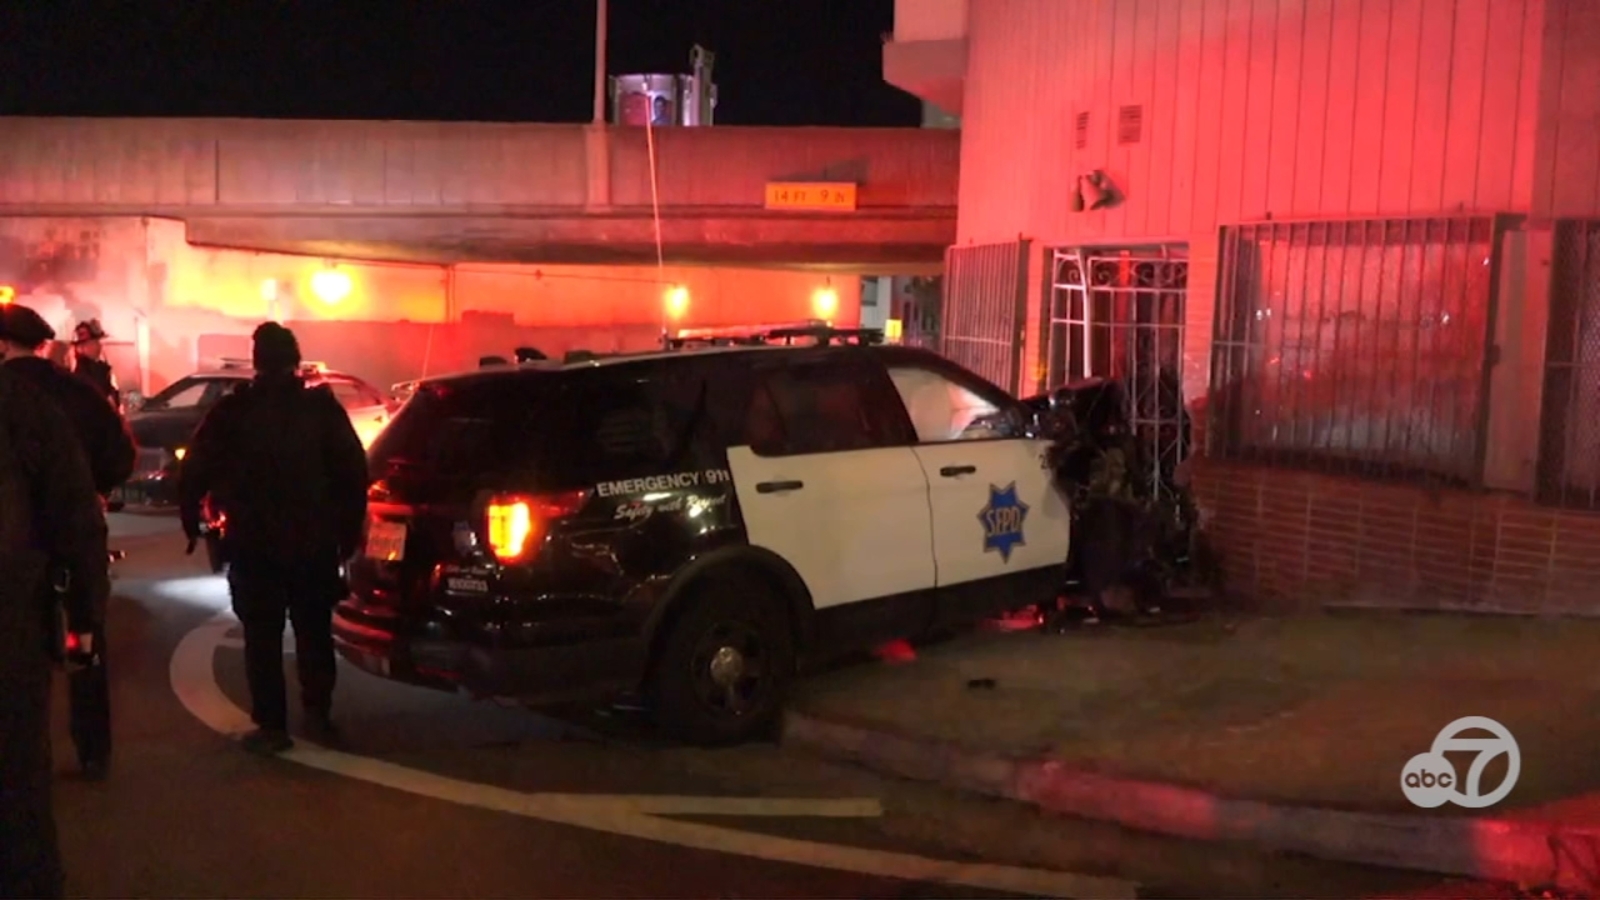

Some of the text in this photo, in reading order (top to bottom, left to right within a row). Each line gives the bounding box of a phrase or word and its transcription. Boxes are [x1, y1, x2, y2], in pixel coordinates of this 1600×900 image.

[774, 190, 788, 203] 14
[820, 189, 829, 203] 9
[596, 469, 731, 497] EMERGENCY 911
[613, 503, 654, 528] Safety
[986, 506, 1021, 537] SFPD
